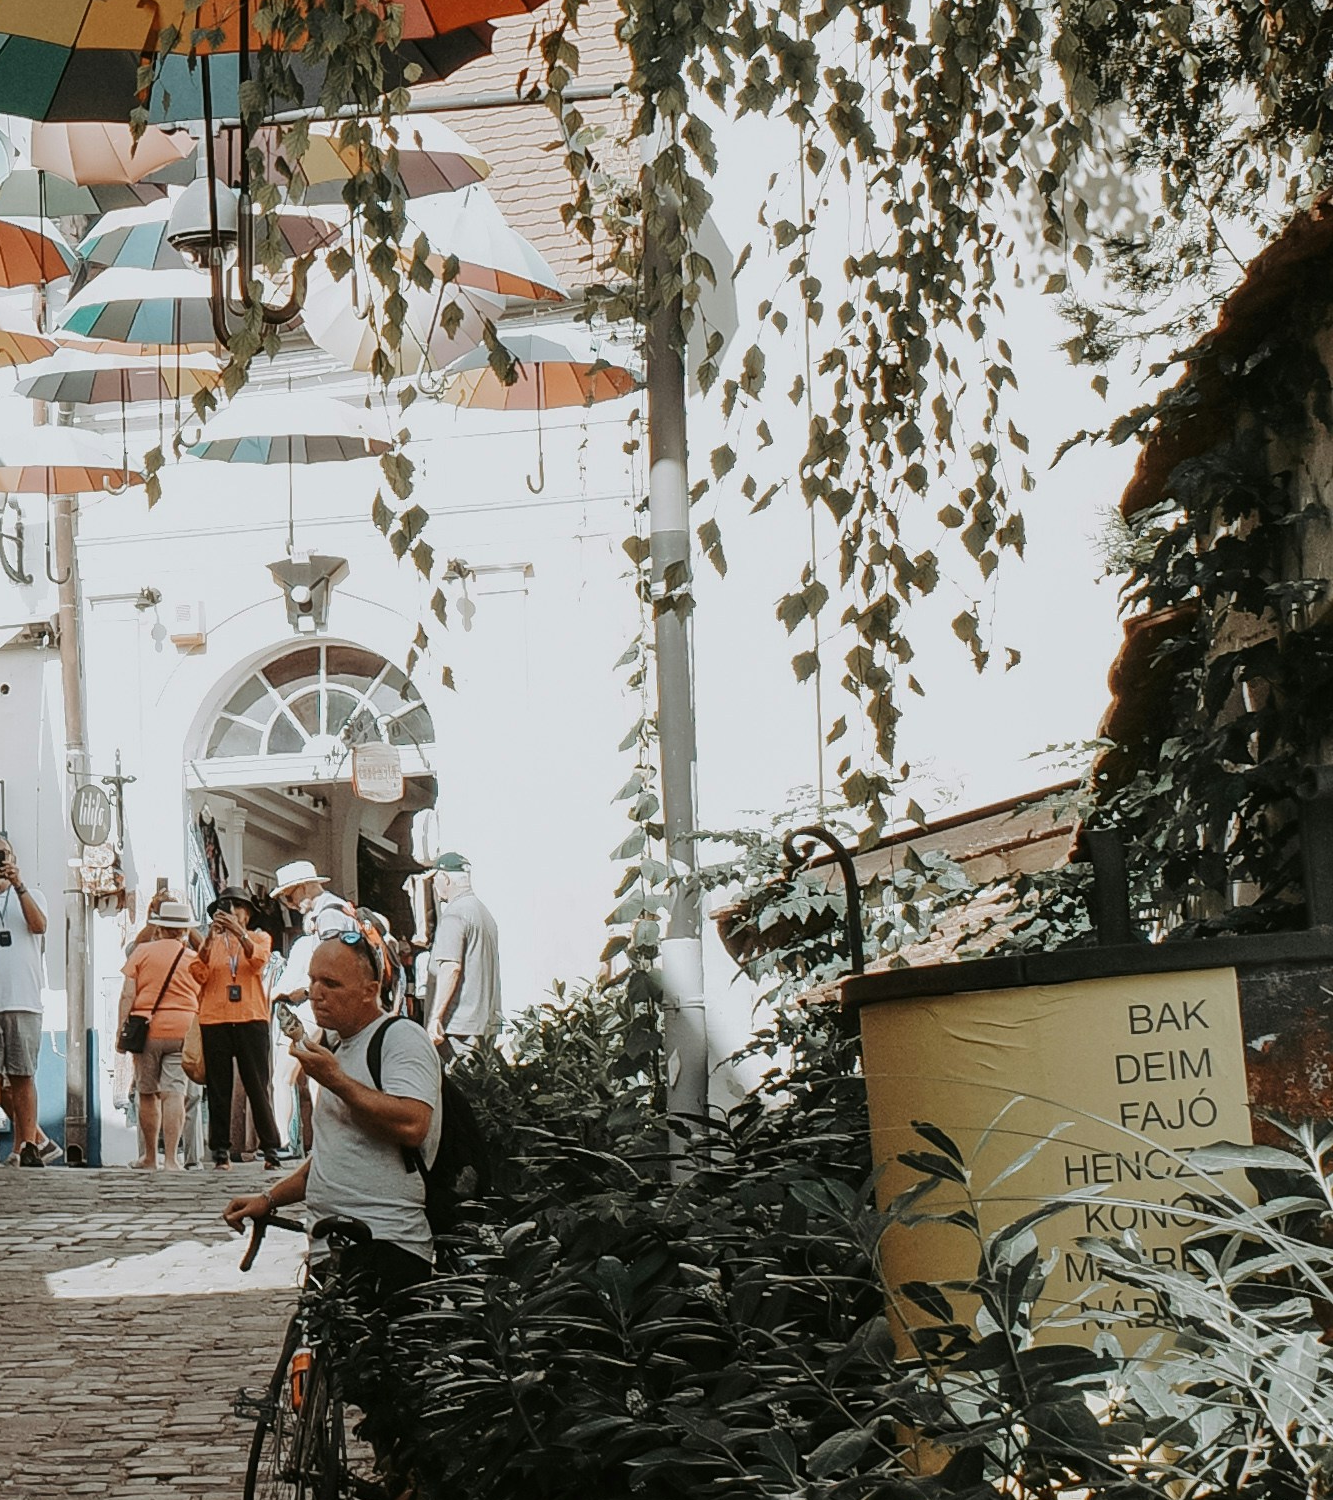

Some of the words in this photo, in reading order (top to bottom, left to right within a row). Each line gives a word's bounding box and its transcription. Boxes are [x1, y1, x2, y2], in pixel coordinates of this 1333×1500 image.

[1128, 999, 1210, 1035] BAK
[1115, 1047, 1213, 1085] DEIM
[1119, 1088, 1218, 1131] FAJÓ
